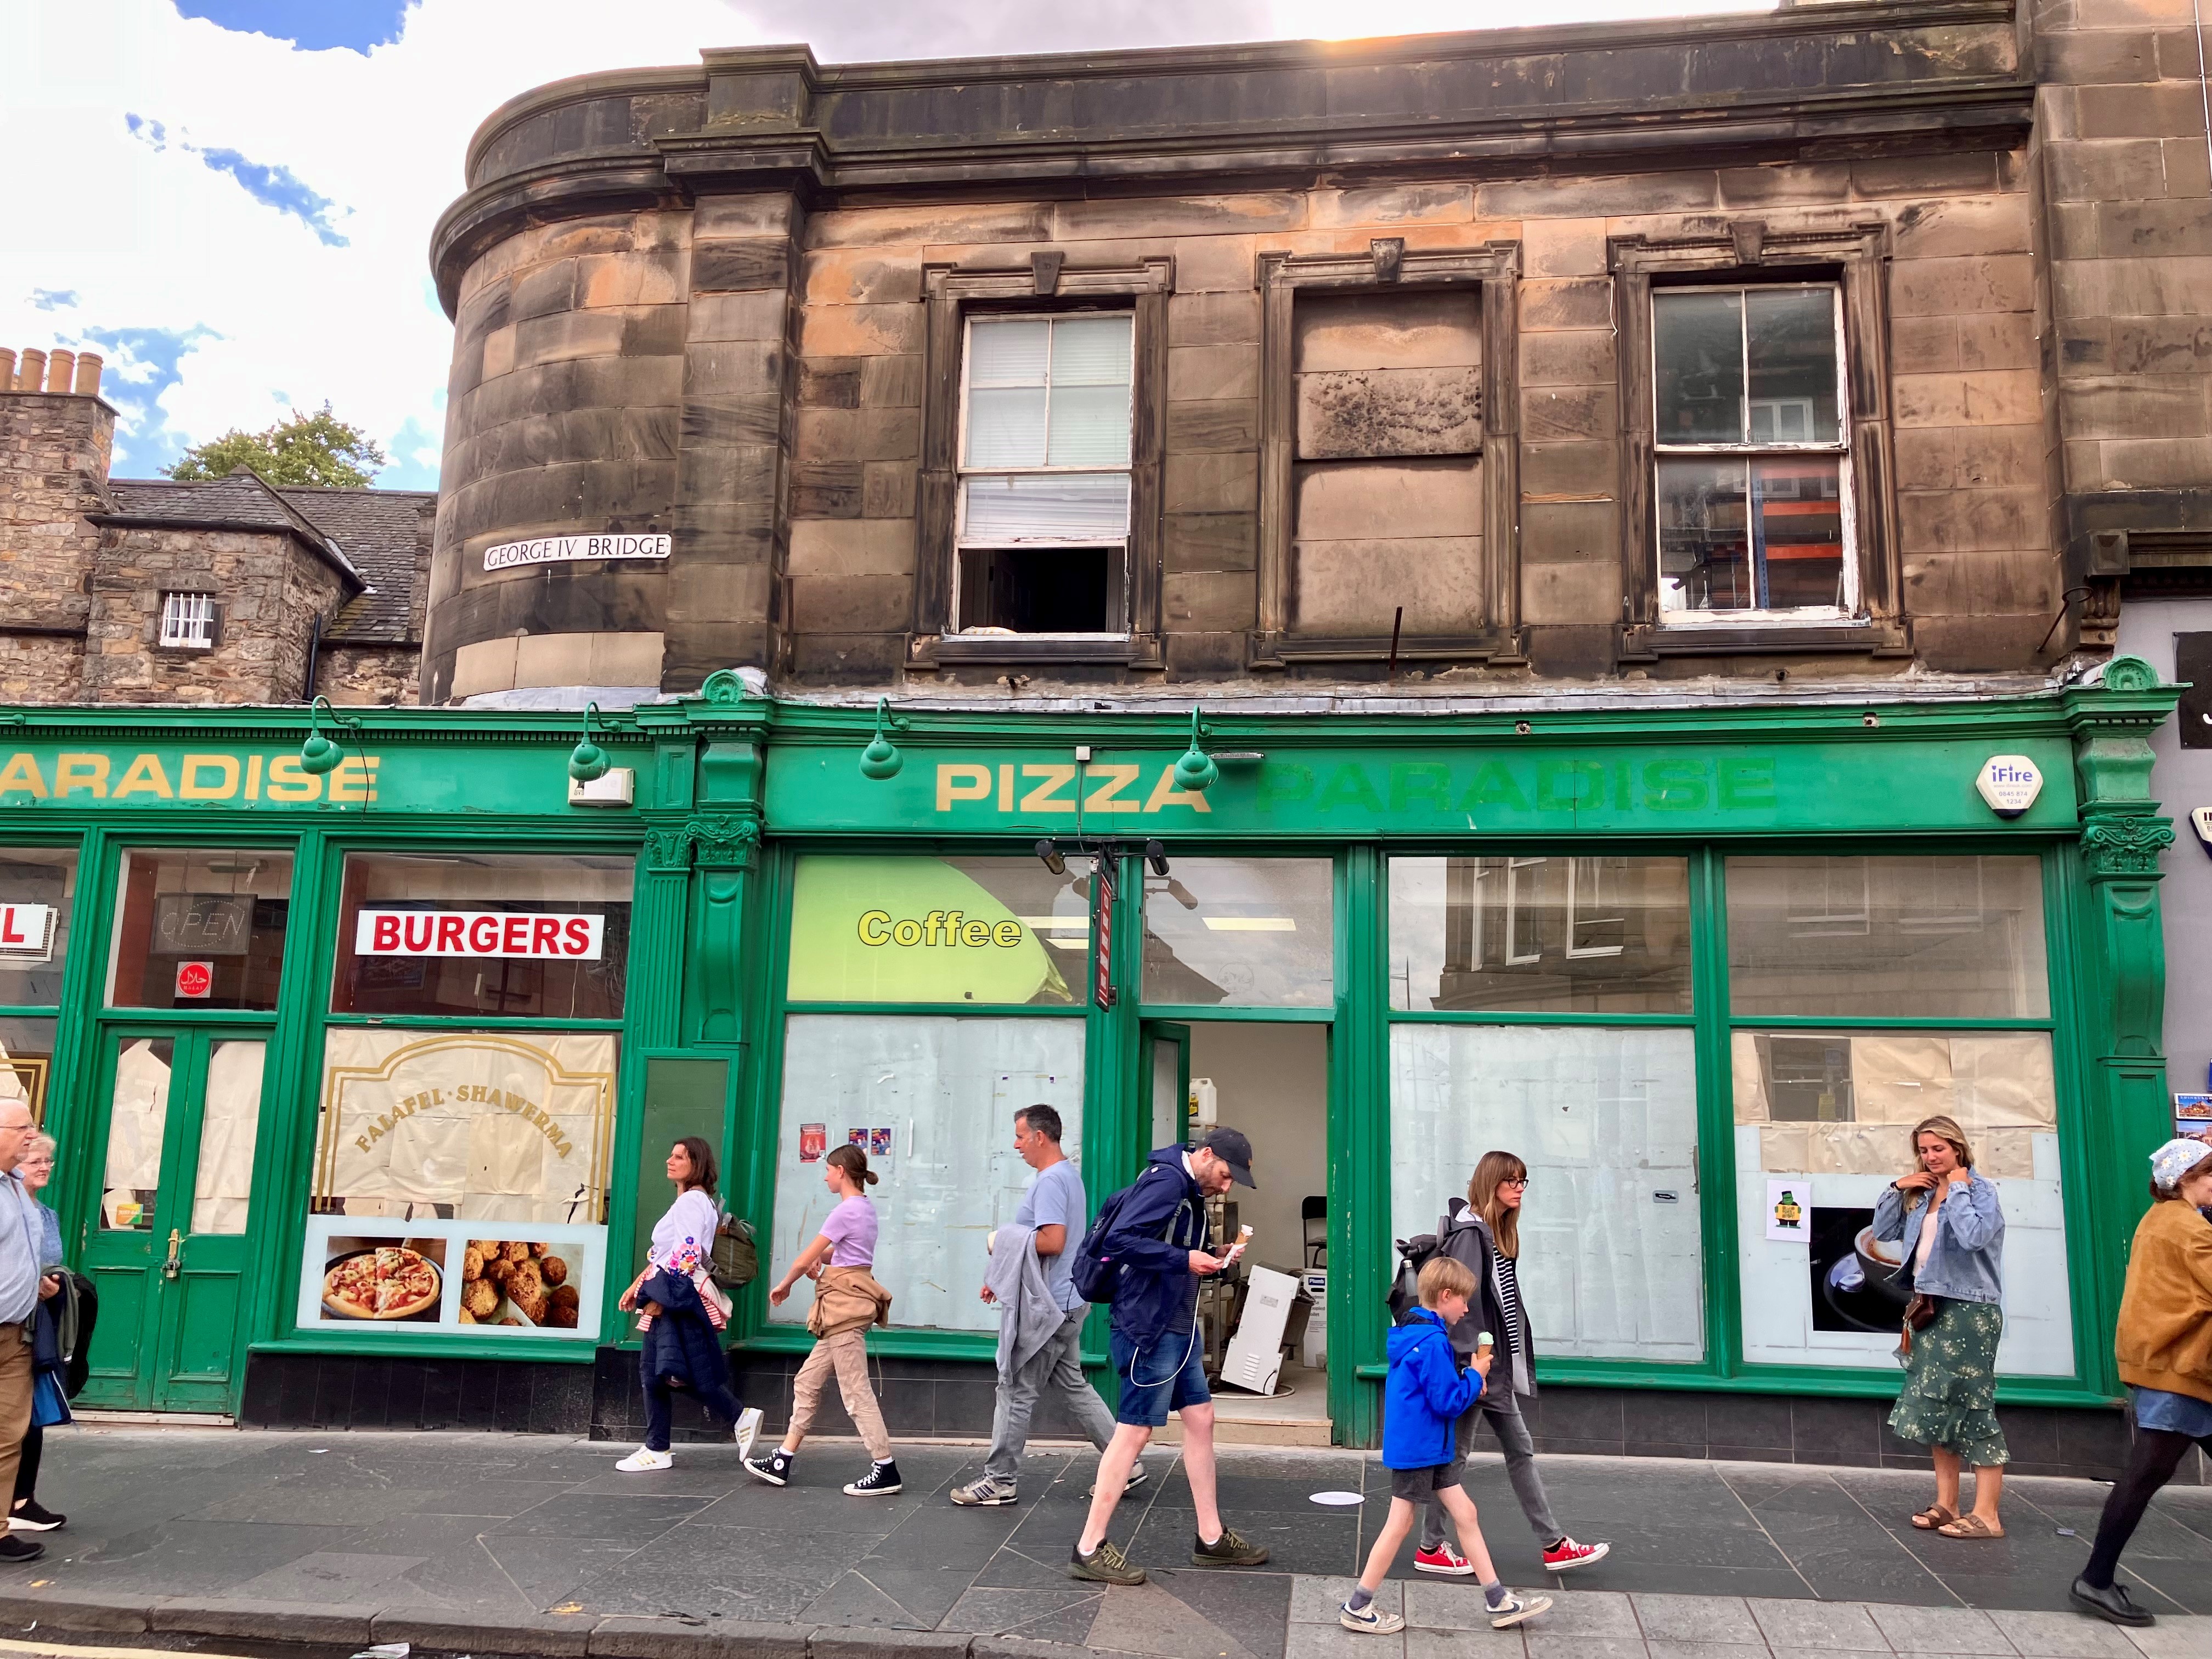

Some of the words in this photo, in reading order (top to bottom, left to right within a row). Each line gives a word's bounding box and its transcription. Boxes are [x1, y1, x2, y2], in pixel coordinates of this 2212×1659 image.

[488, 541, 552, 567] GEORGE
[558, 539, 578, 557] IV
[587, 537, 667, 556] BRIDGE
[936, 764, 1212, 812] PIZZA
[1256, 758, 1776, 812] PARADISE
[1991, 764, 2033, 782] iFire
[161, 911, 245, 935] OPEN
[373, 916, 590, 955] BURGERS
[858, 910, 1022, 947] Coffee
[354, 1087, 445, 1153] FALAFEL
[455, 1084, 573, 1159] SHAWERMA
